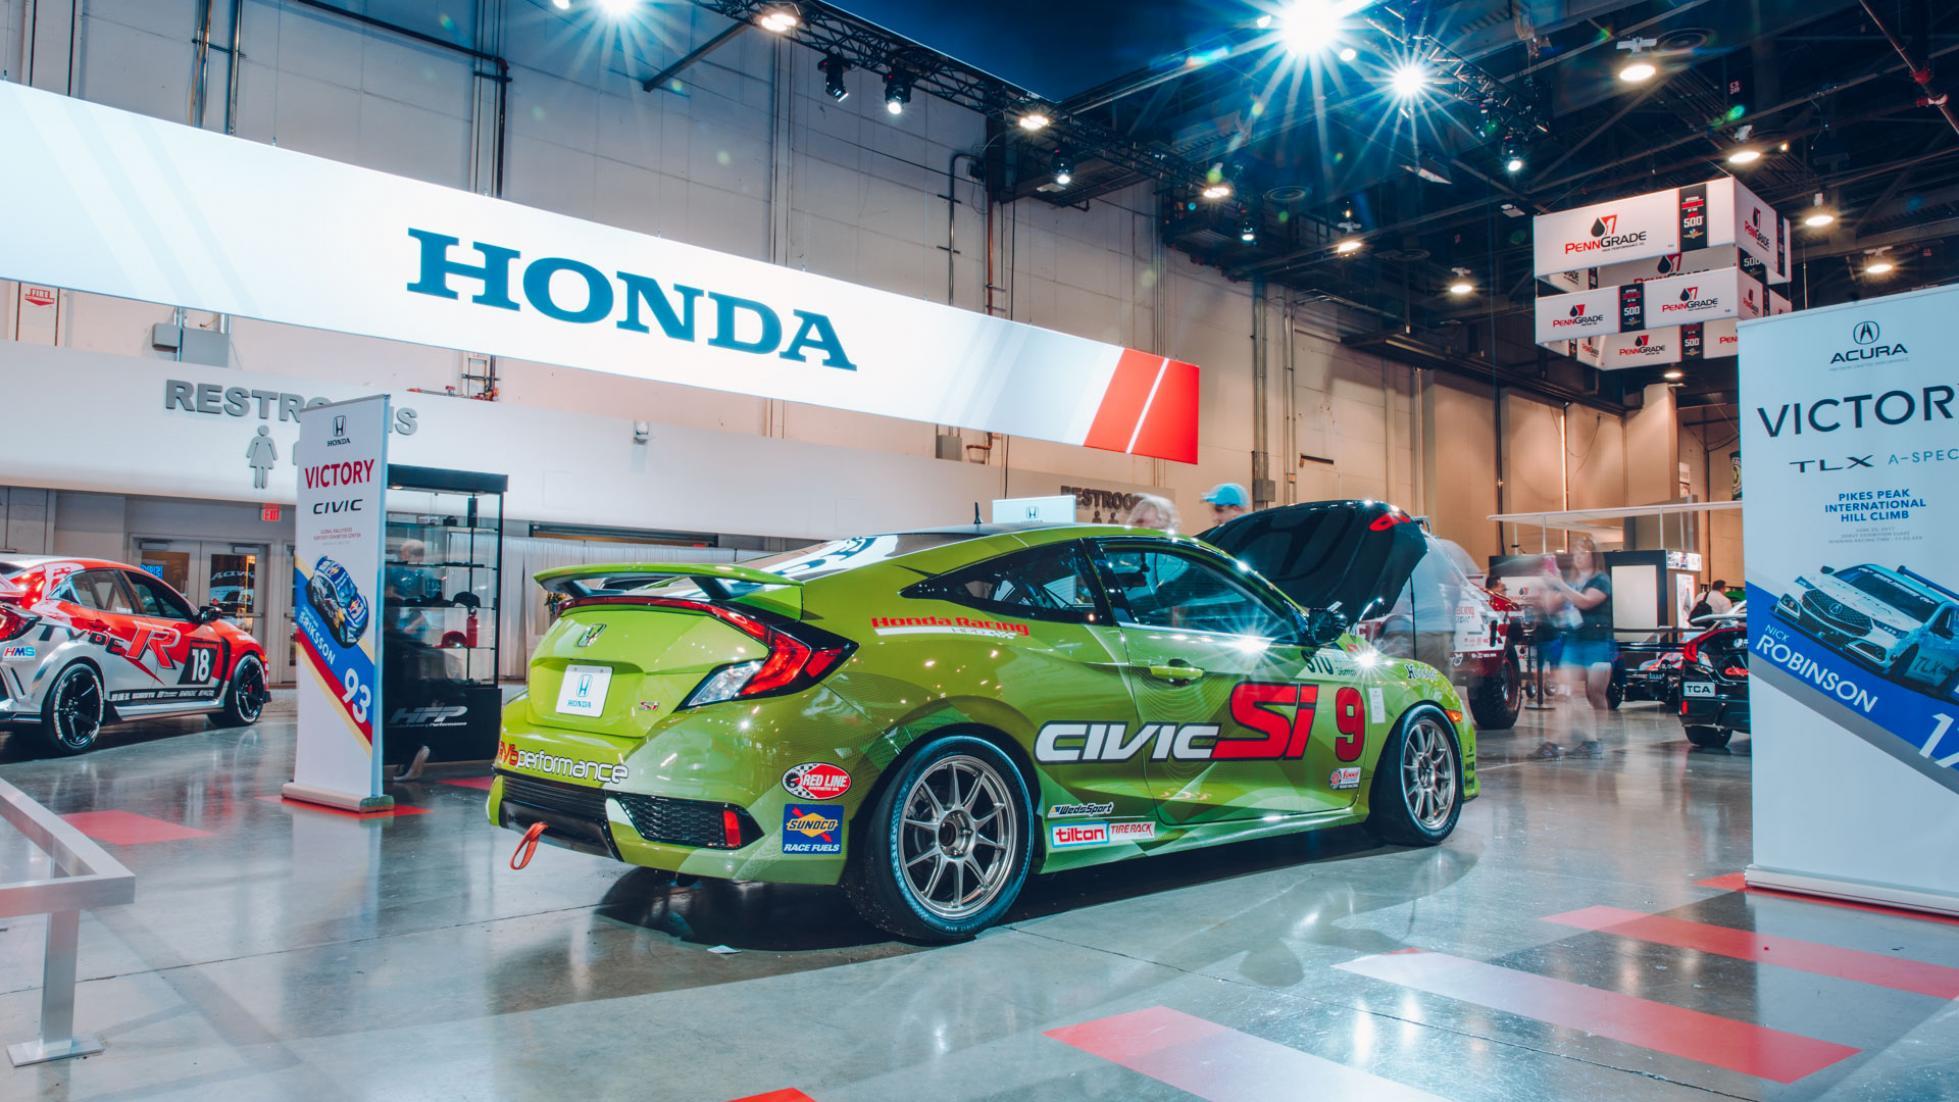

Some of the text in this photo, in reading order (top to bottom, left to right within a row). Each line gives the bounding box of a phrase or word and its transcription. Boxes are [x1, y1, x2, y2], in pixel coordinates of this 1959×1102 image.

[1684, 216, 1703, 227] 500
[407, 227, 858, 372] HONDA
[1624, 306, 1640, 316] 500
[1684, 339, 1700, 347] 500
[1830, 343, 1908, 365] ACURA
[1757, 382, 1959, 438] VICTOR
[1789, 455, 1874, 473] TLX
[305, 458, 375, 490] VICTORY
[1839, 488, 1910, 502] PIKES PEAK
[313, 499, 364, 515] CIVIC
[1825, 498, 1926, 513] INTERNATIONAL
[1841, 510, 1910, 522] HILL CLIMB
[871, 616, 952, 629] Honda
[955, 617, 1030, 637] Racing
[1765, 624, 1790, 643] NICK
[126, 620, 180, 669] R
[298, 611, 337, 666] ERIKSSON
[4, 646, 36, 656] HMS
[192, 648, 210, 682] 18
[1756, 633, 1879, 714] ROBINSON
[342, 668, 371, 724] 93
[1686, 685, 1711, 694] TCA
[567, 698, 592, 709] HONDA
[1211, 681, 1319, 762] Si
[1335, 687, 1365, 762] 9
[1035, 720, 1221, 764] CIVIC
[802, 774, 848, 787] RED LINE
[1059, 801, 1113, 815] WedsSport
[788, 819, 837, 830] SUNOCO
[1056, 827, 1105, 843] tilton
[783, 843, 840, 852] RACE FUELS
